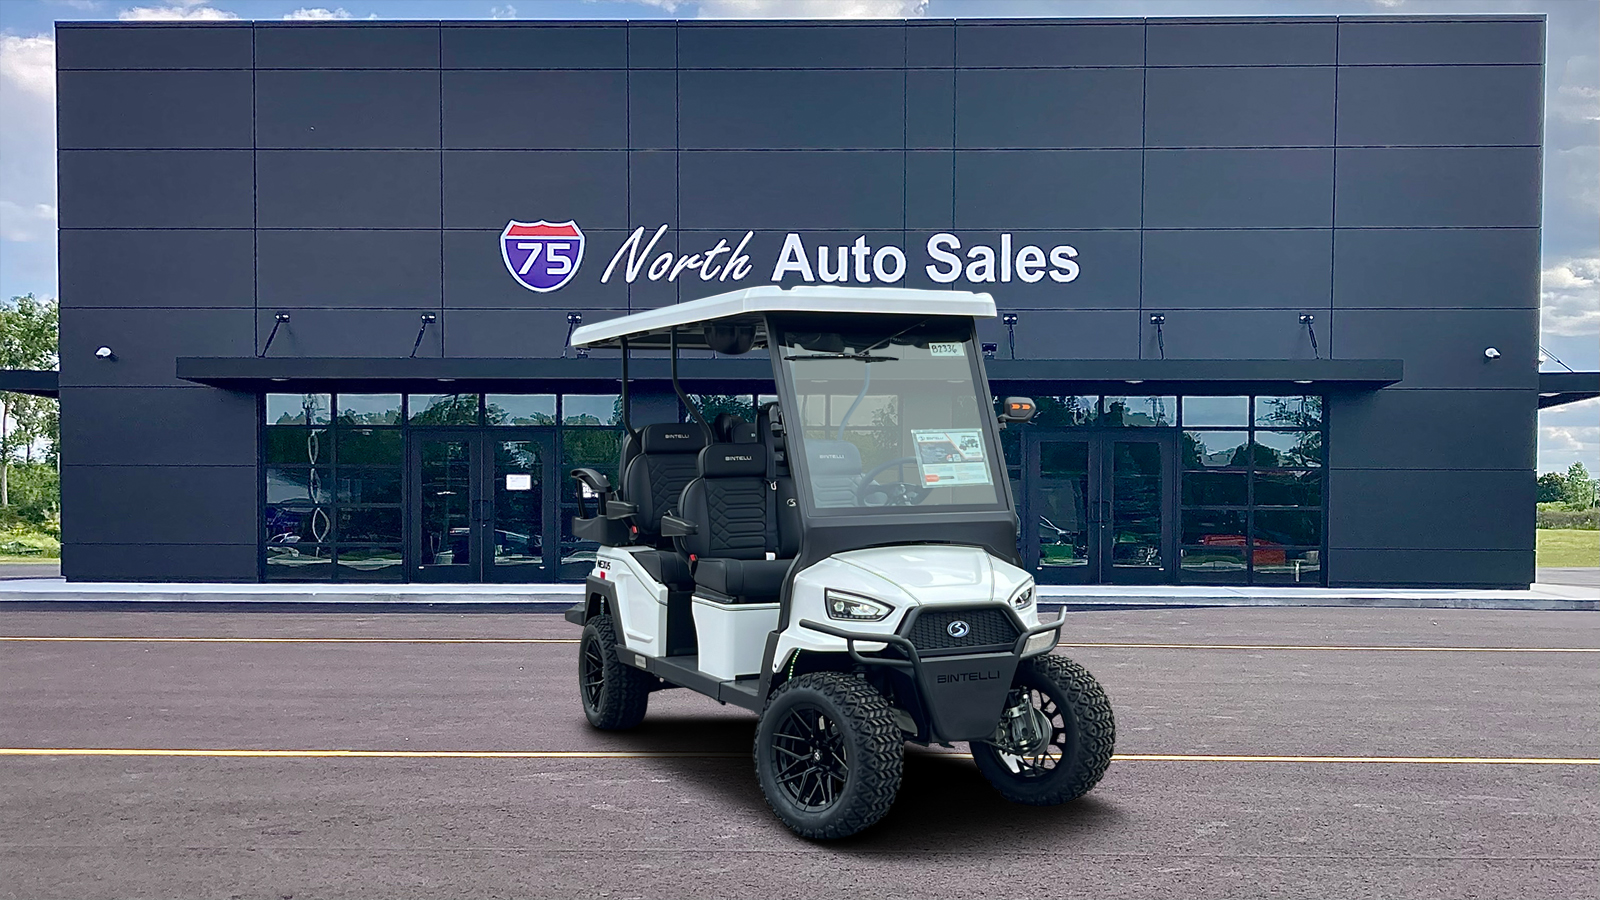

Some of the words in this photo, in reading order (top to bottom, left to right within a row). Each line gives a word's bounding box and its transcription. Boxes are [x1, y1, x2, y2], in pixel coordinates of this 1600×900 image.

[517, 242, 573, 276] 75
[600, 224, 756, 284] North
[771, 233, 907, 284] Auto
[925, 233, 1081, 284] Sales
[937, 670, 1000, 684] BINTELLI
